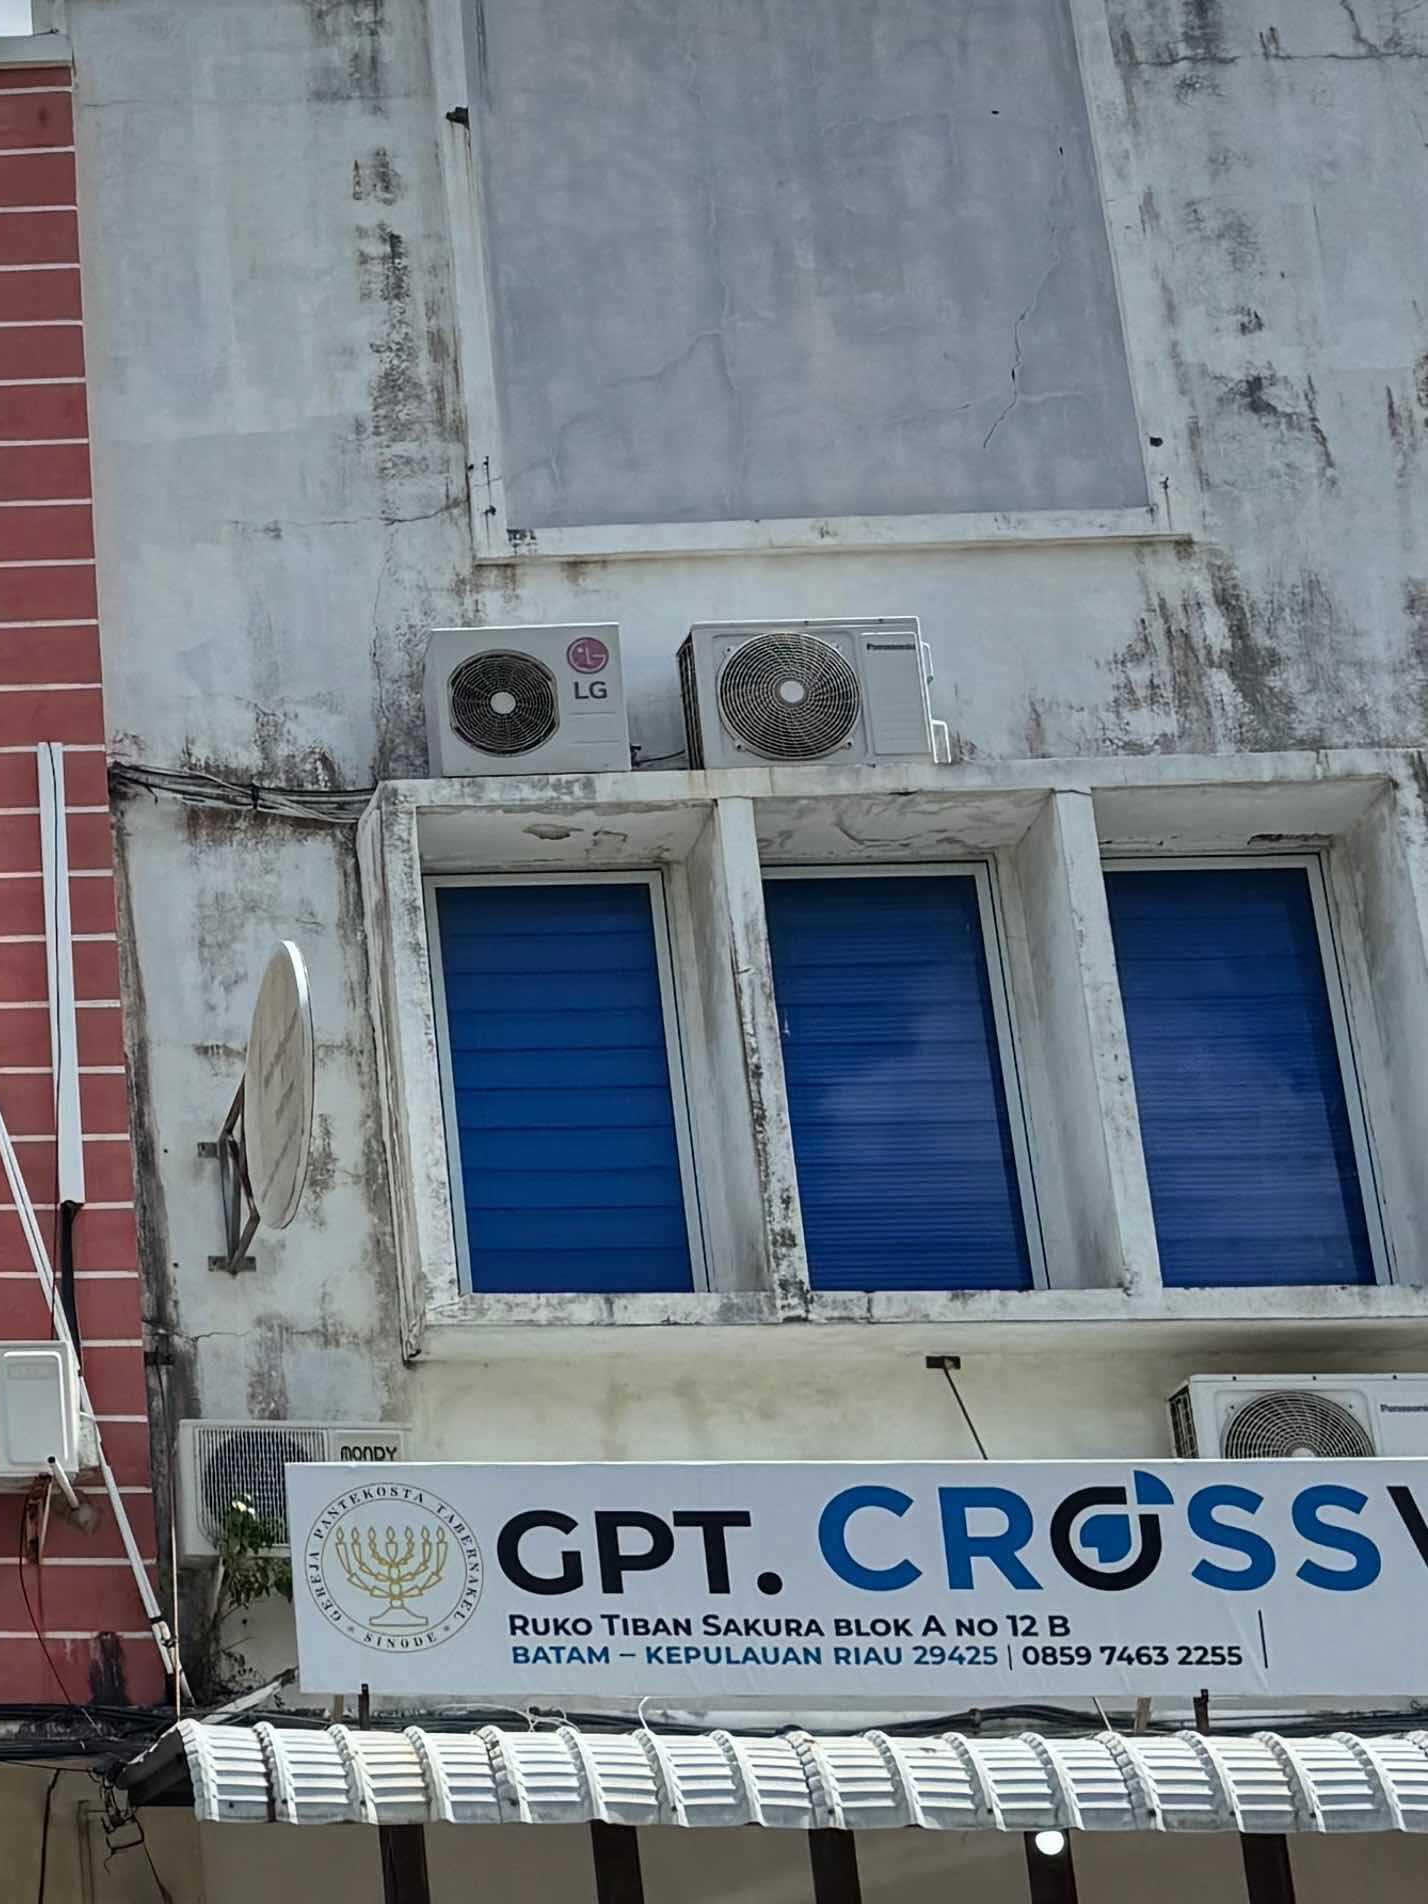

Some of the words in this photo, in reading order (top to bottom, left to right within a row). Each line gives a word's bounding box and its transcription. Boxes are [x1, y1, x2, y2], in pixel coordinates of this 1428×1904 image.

[574, 680, 608, 700] LG
[313, 1486, 425, 1540] PANTEKOSTA
[435, 1502, 481, 1621] TABERNAKEL
[496, 1508, 782, 1597] GPT.
[308, 1550, 342, 1623] GEREJA
[363, 1631, 438, 1649] SINODE
[922, 1614, 946, 1638] A
[1006, 1614, 1039, 1638] 12
[1048, 1614, 1072, 1638] B
[512, 1645, 610, 1666] BATAM
[646, 1645, 822, 1666] KEPULAUAN
[834, 1645, 903, 1666] RIAU
[912, 1645, 999, 1666] 29425
[1021, 1645, 1092, 1666] 0859
[1099, 1645, 1170, 1666] 7463
[1176, 1645, 1243, 1666] 2255
